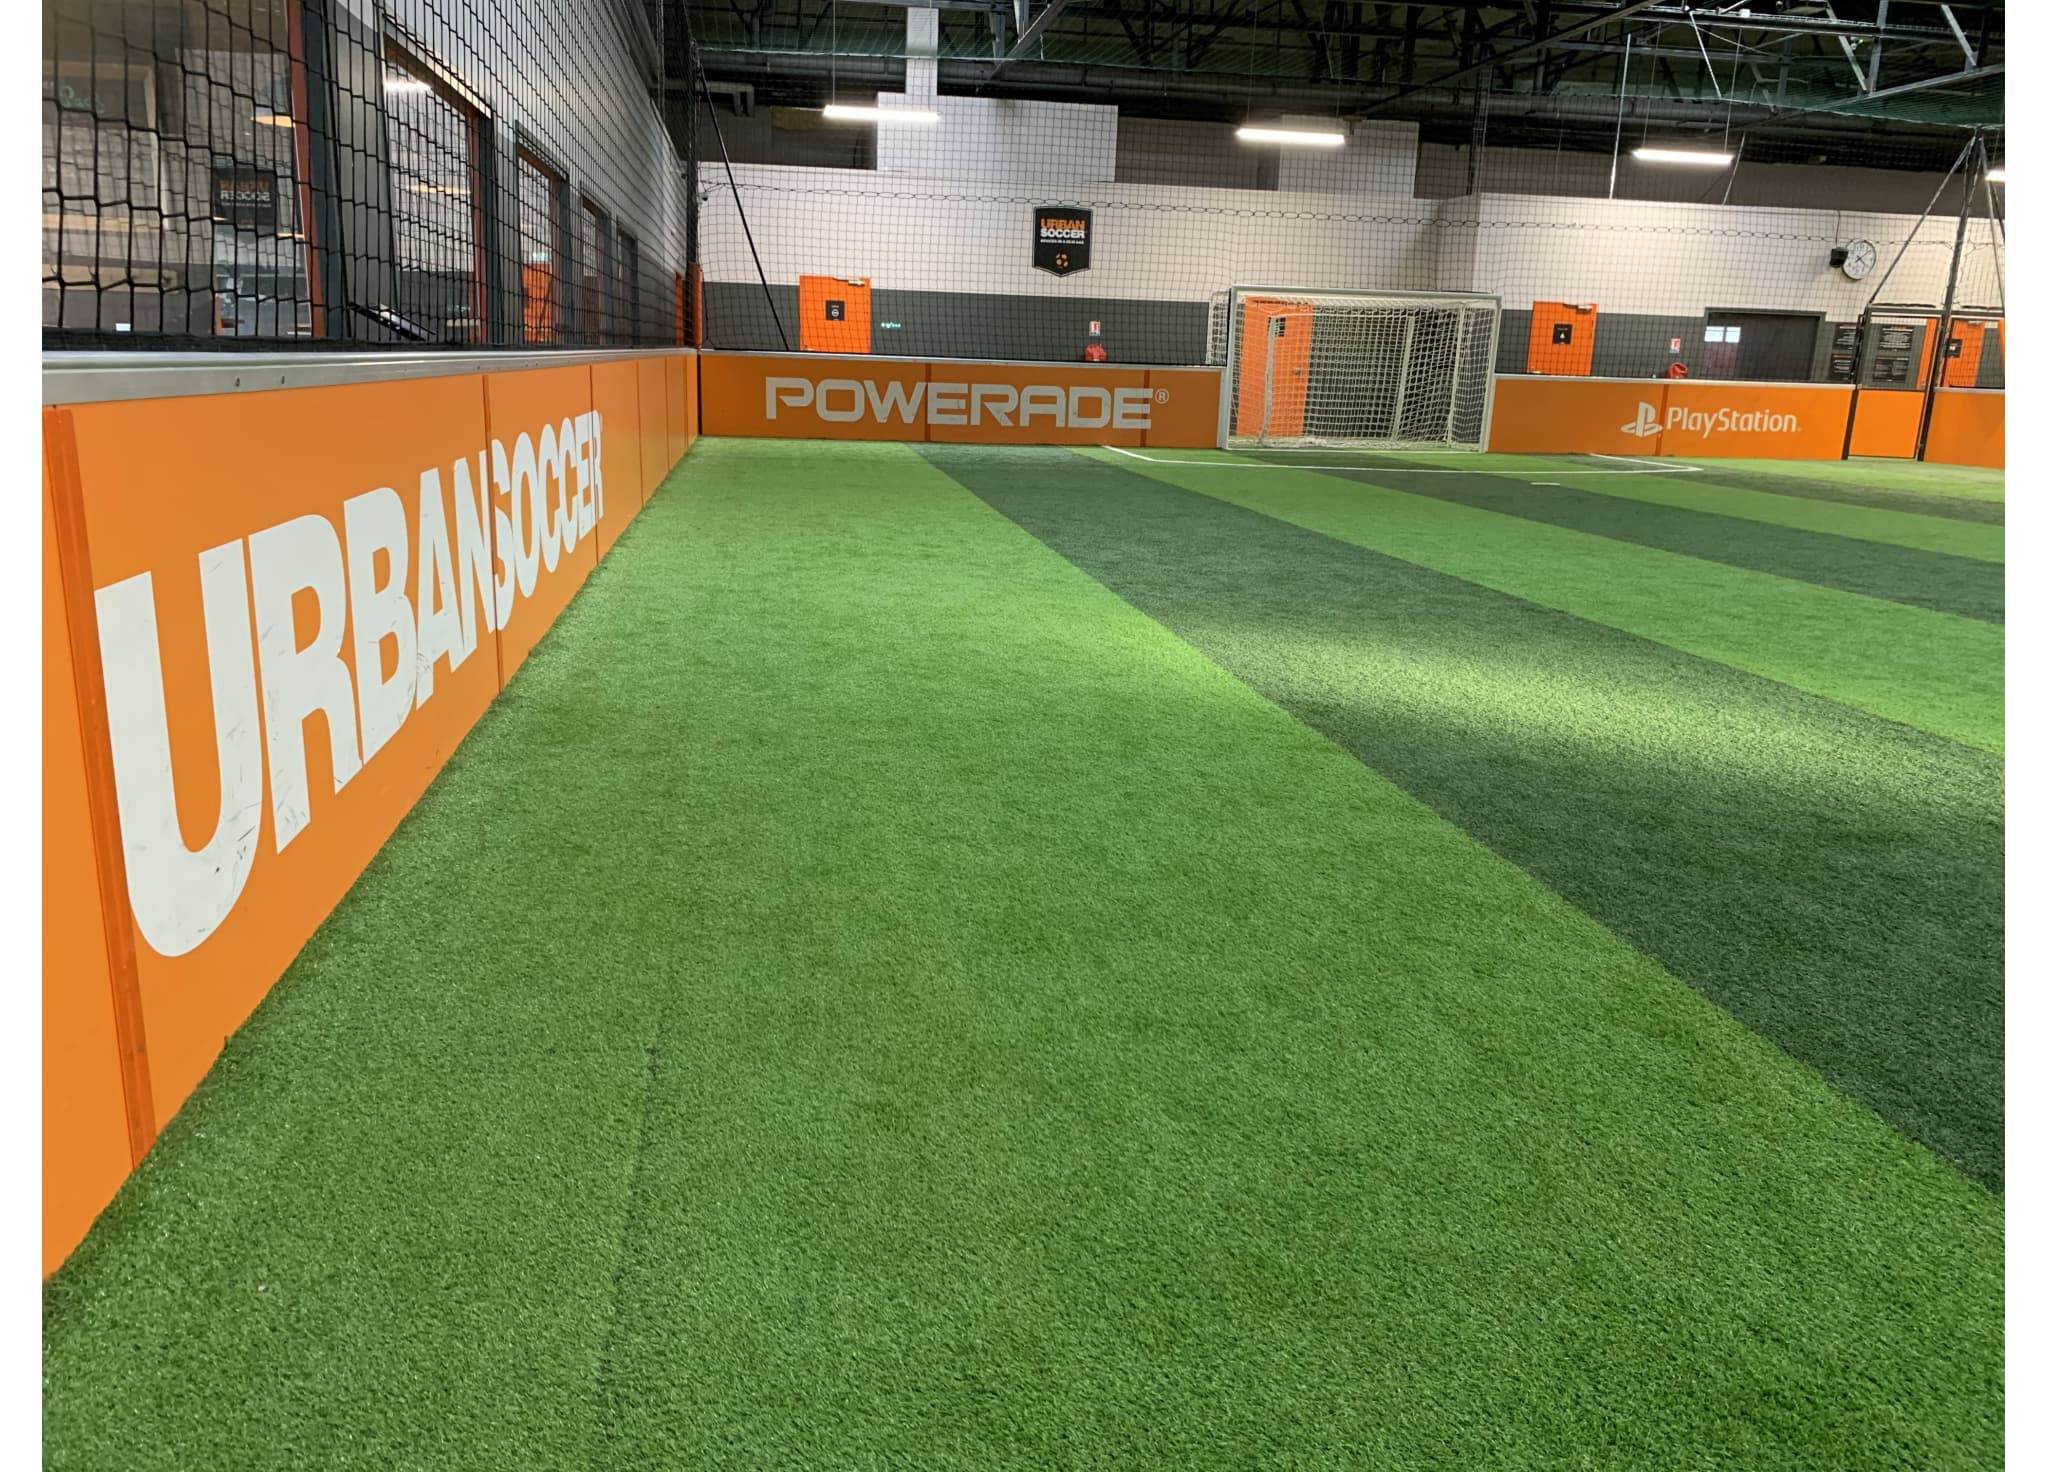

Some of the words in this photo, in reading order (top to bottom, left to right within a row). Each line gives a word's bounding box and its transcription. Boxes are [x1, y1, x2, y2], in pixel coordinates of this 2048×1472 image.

[1041, 218, 1085, 230] URBAN
[1041, 228, 1085, 239] SOCCER
[1666, 406, 1798, 439] PlayStation
